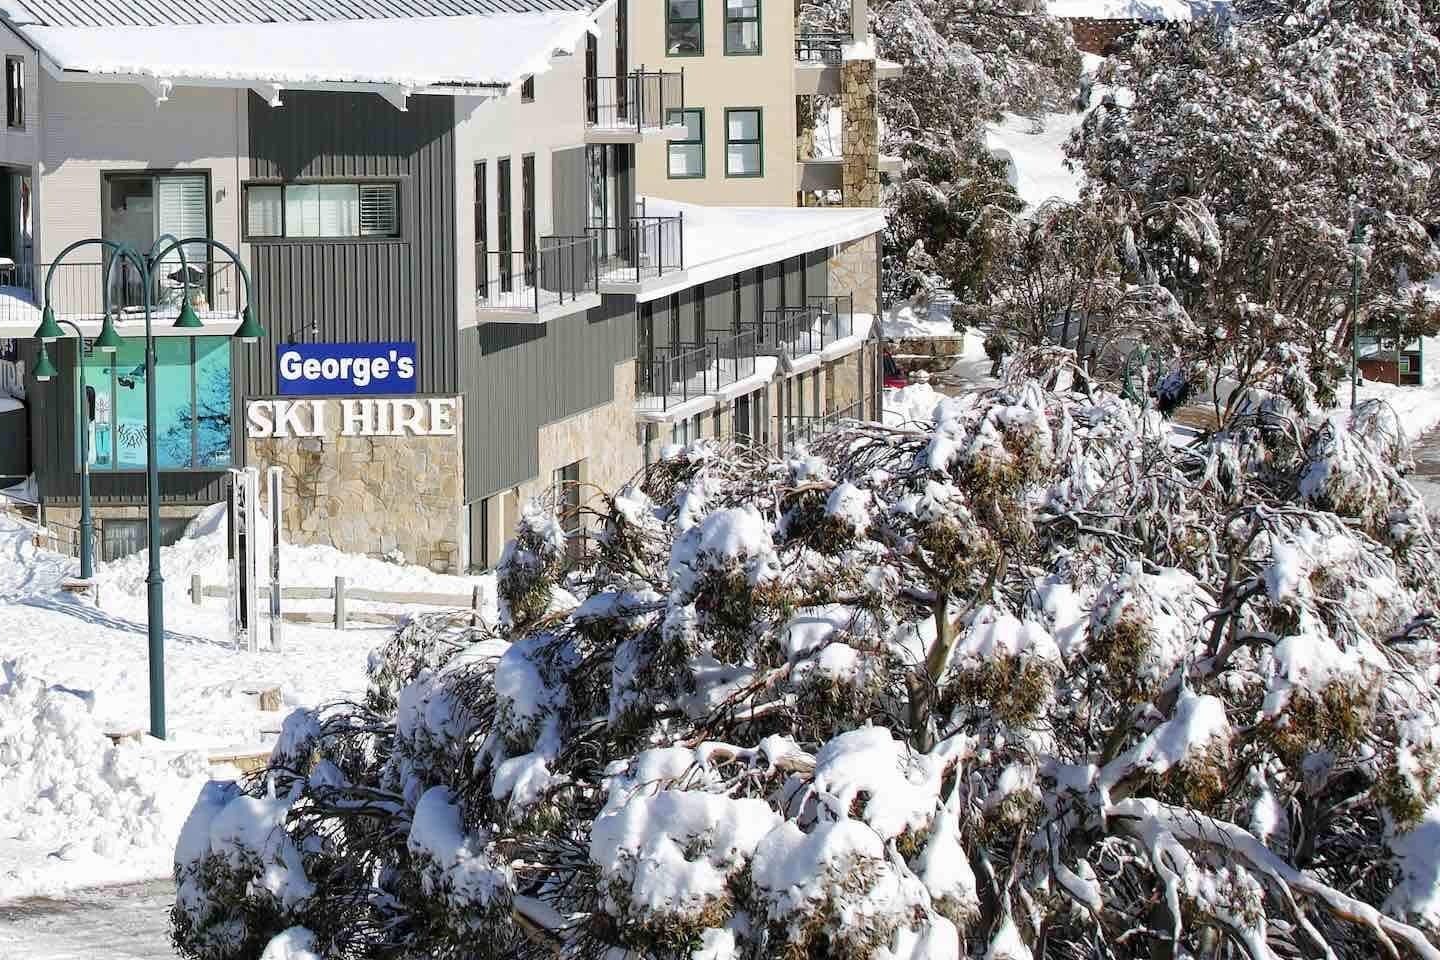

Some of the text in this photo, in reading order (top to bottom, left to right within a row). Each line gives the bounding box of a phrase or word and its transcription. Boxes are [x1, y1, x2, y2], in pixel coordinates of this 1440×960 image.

[279, 350, 414, 387] George's
[246, 398, 457, 437] SKI HIRE
